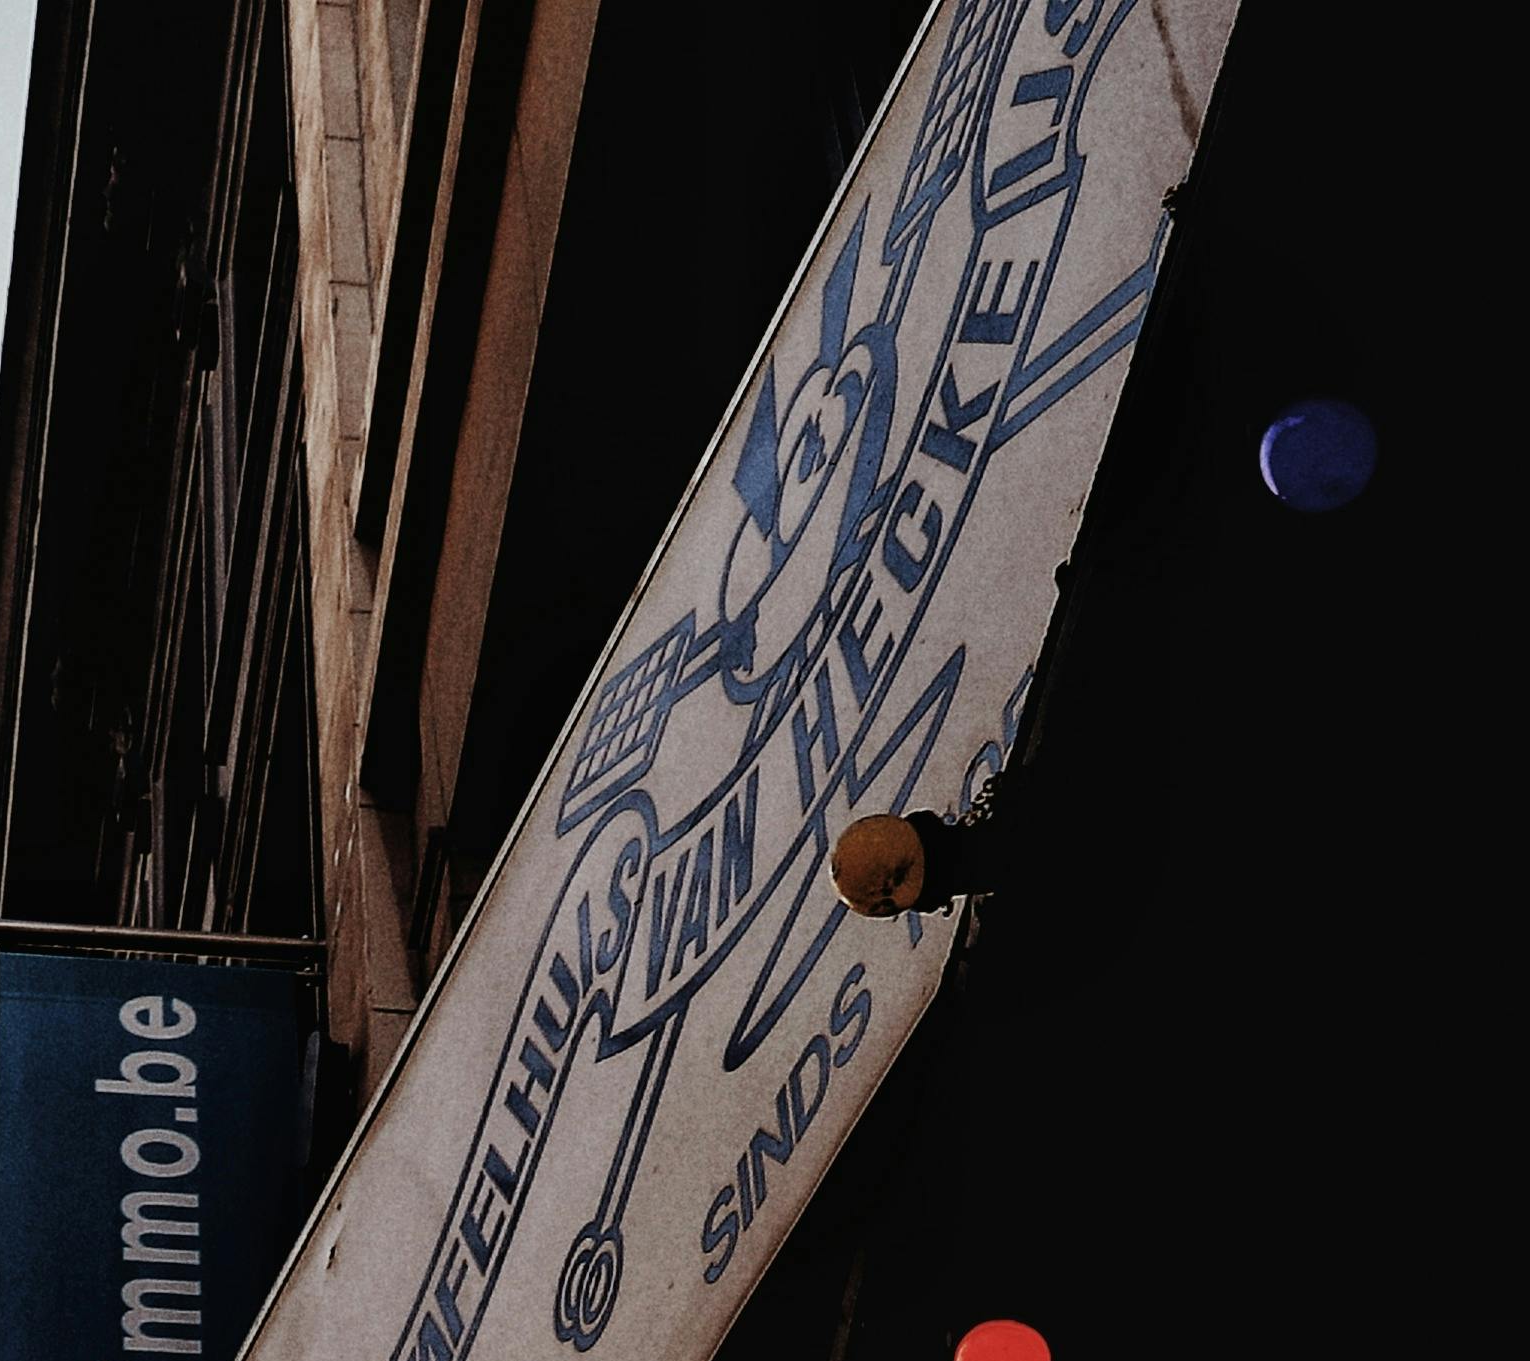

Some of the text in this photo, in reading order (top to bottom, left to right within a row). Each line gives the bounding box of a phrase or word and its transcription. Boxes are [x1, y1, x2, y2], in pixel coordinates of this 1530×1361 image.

[646, 764, 760, 1000] VAN
[790, 259, 1041, 717] HECKE
[701, 962, 872, 1285] SINDS
